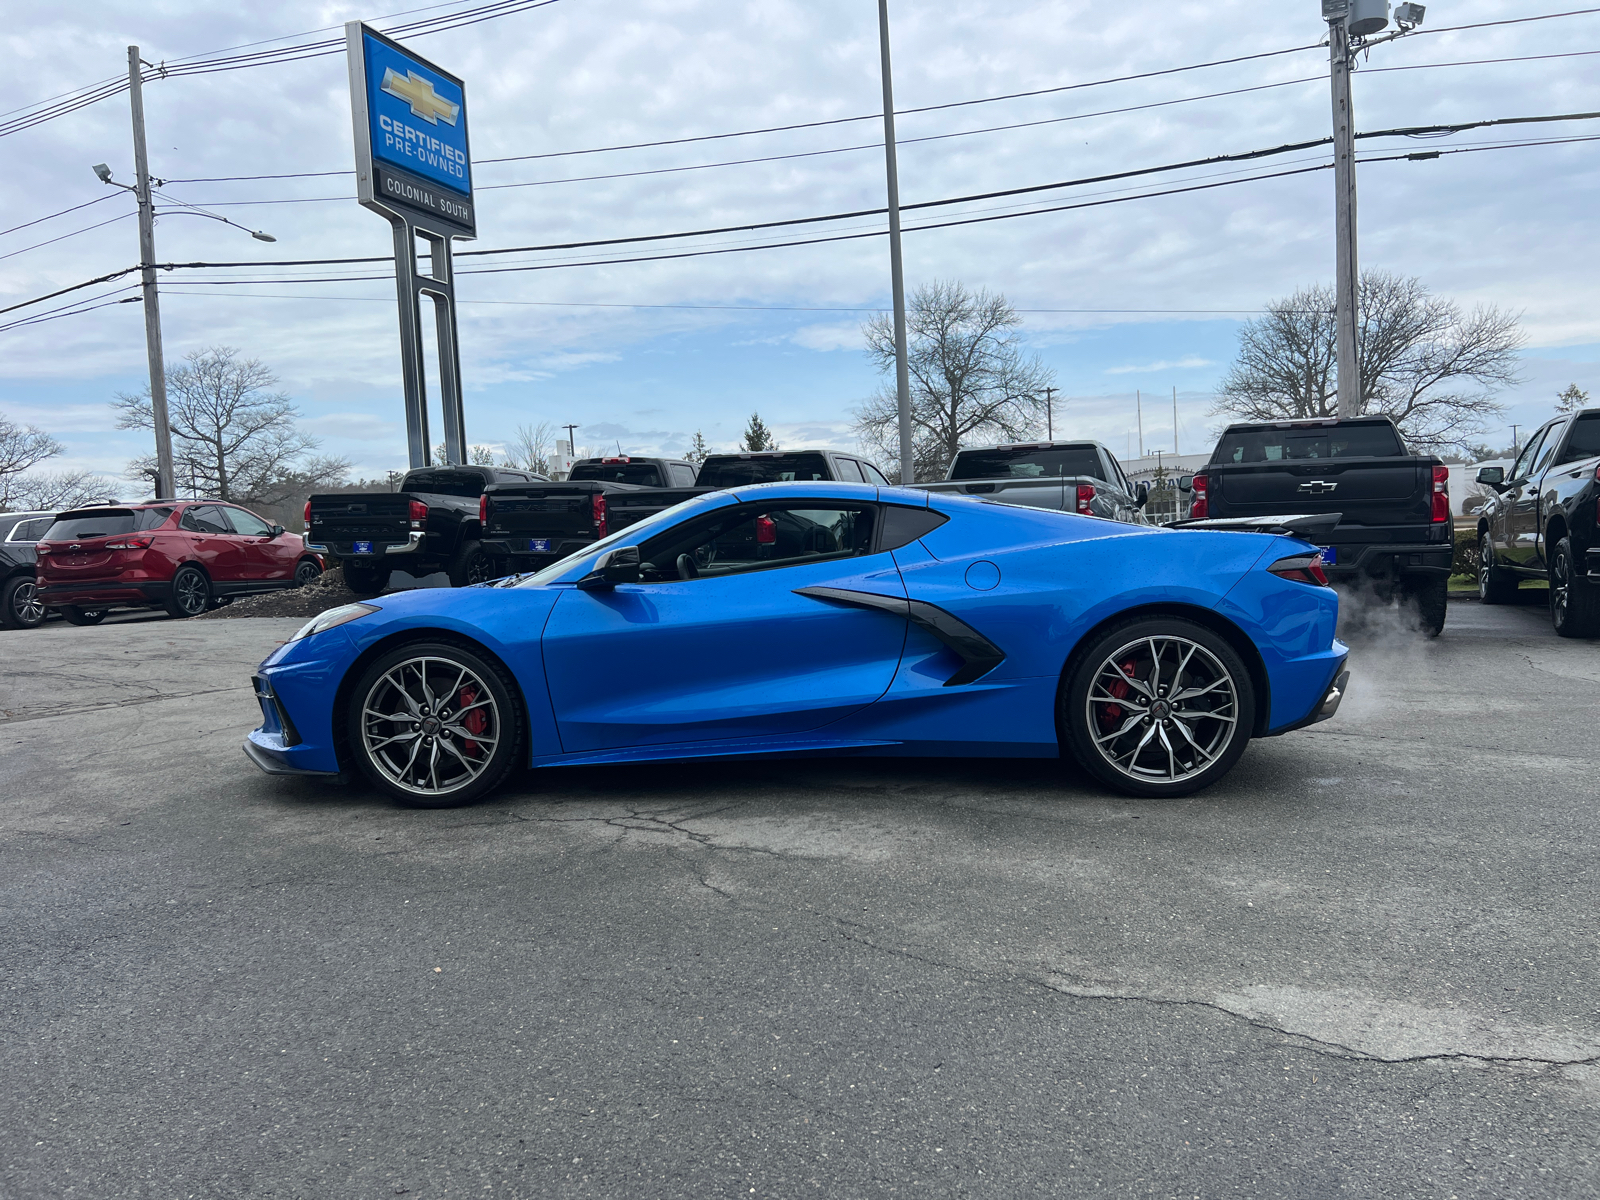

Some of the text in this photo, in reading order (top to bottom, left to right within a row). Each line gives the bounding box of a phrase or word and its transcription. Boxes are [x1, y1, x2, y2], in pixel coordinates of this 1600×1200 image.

[379, 114, 466, 165] CERTIFIED
[385, 132, 463, 178] PRE-OWNED
[387, 177, 469, 220] COLONIAL SOUTH
